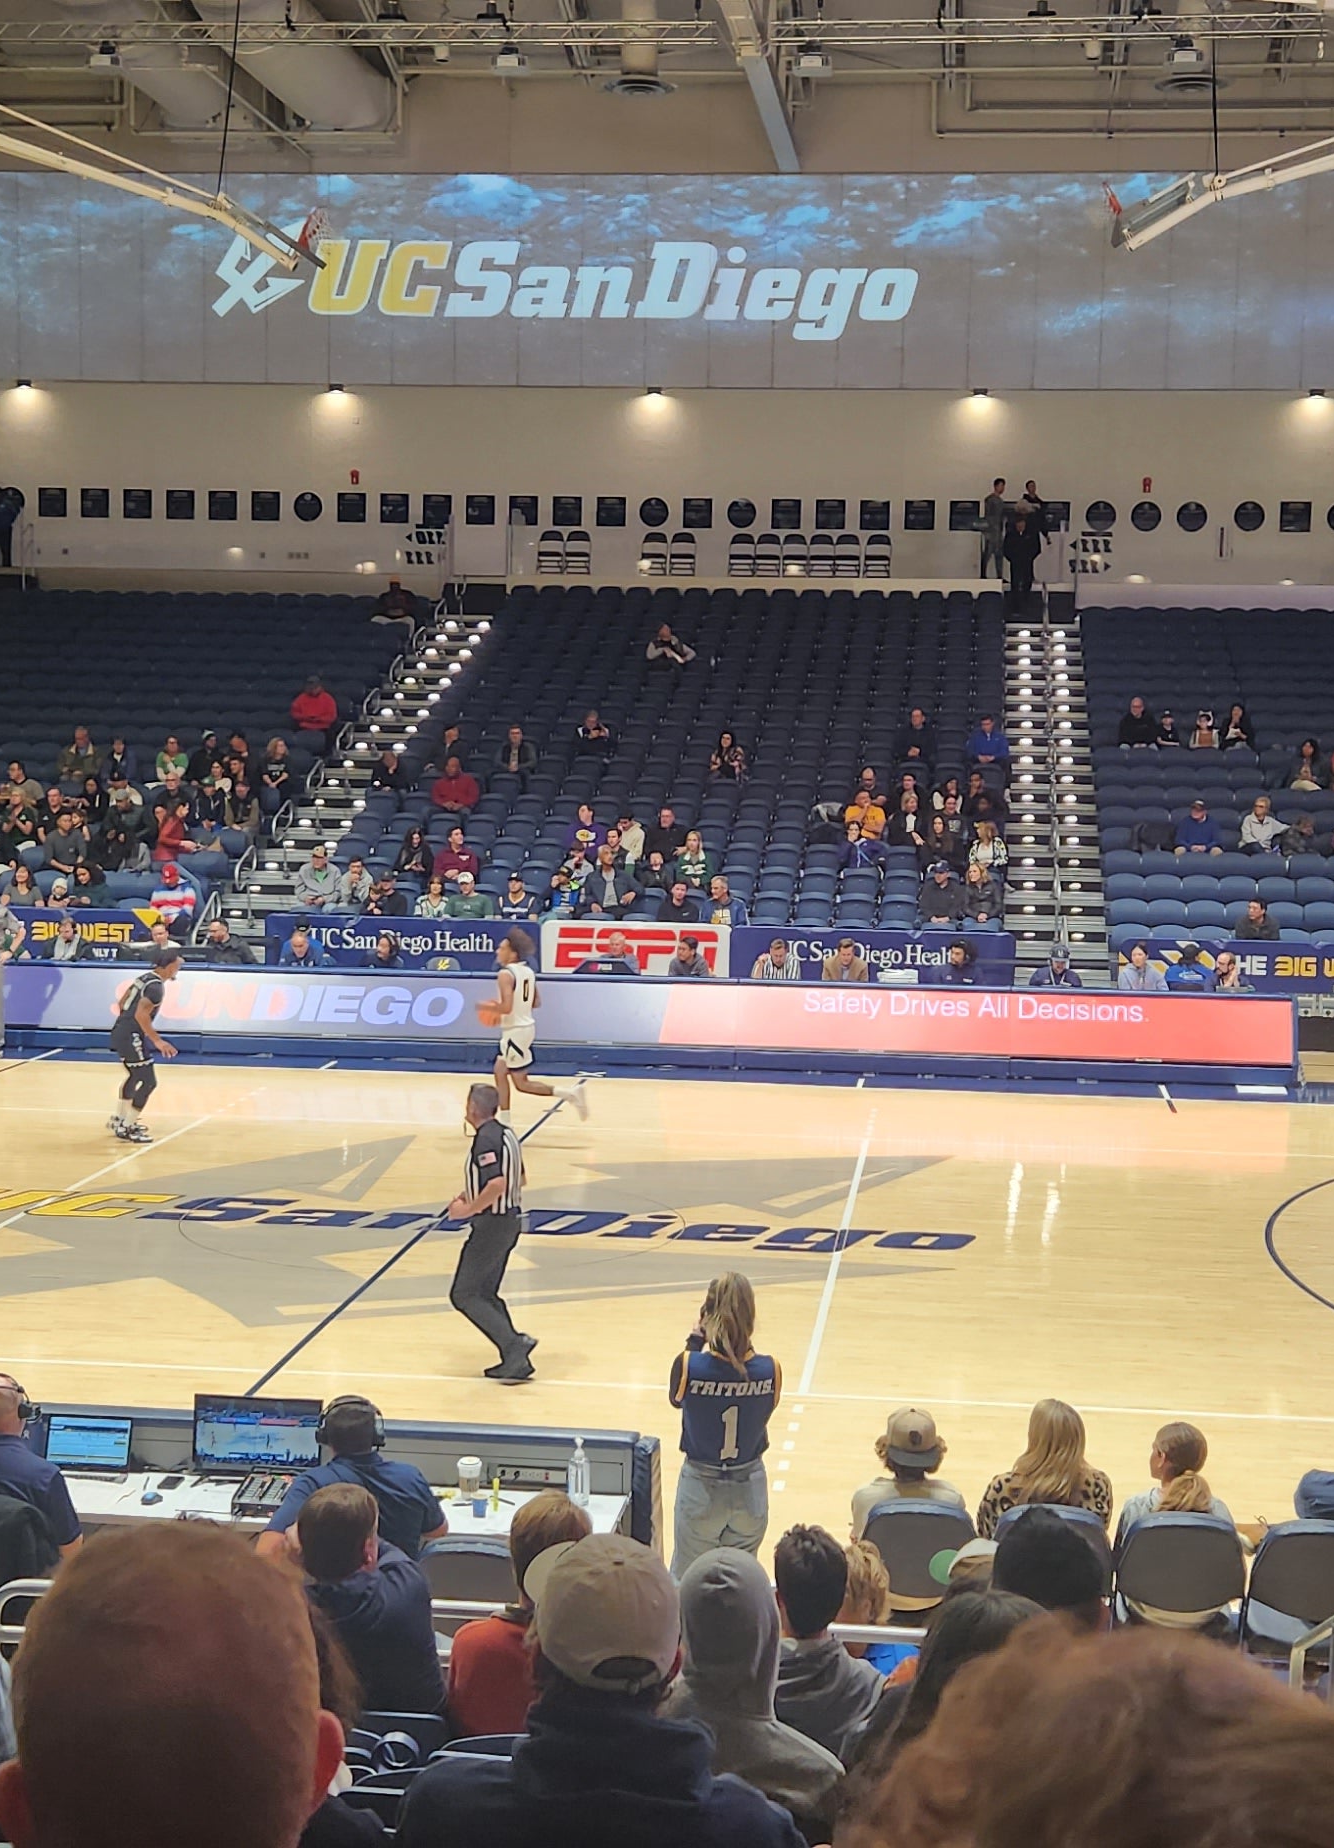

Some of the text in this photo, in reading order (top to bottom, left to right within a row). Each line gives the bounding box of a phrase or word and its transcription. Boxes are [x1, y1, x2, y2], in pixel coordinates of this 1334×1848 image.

[342, 928, 378, 949] San
[434, 931, 494, 952] Health
[555, 927, 718, 971] ESPN
[1234, 955, 1268, 976] HE
[1275, 956, 1317, 977] BIG
[523, 979, 529, 1002] 0
[803, 991, 1149, 1022] Safety Drives All Decisions.
[689, 1379, 773, 1397] TRITONS
[720, 1405, 739, 1460] 1
